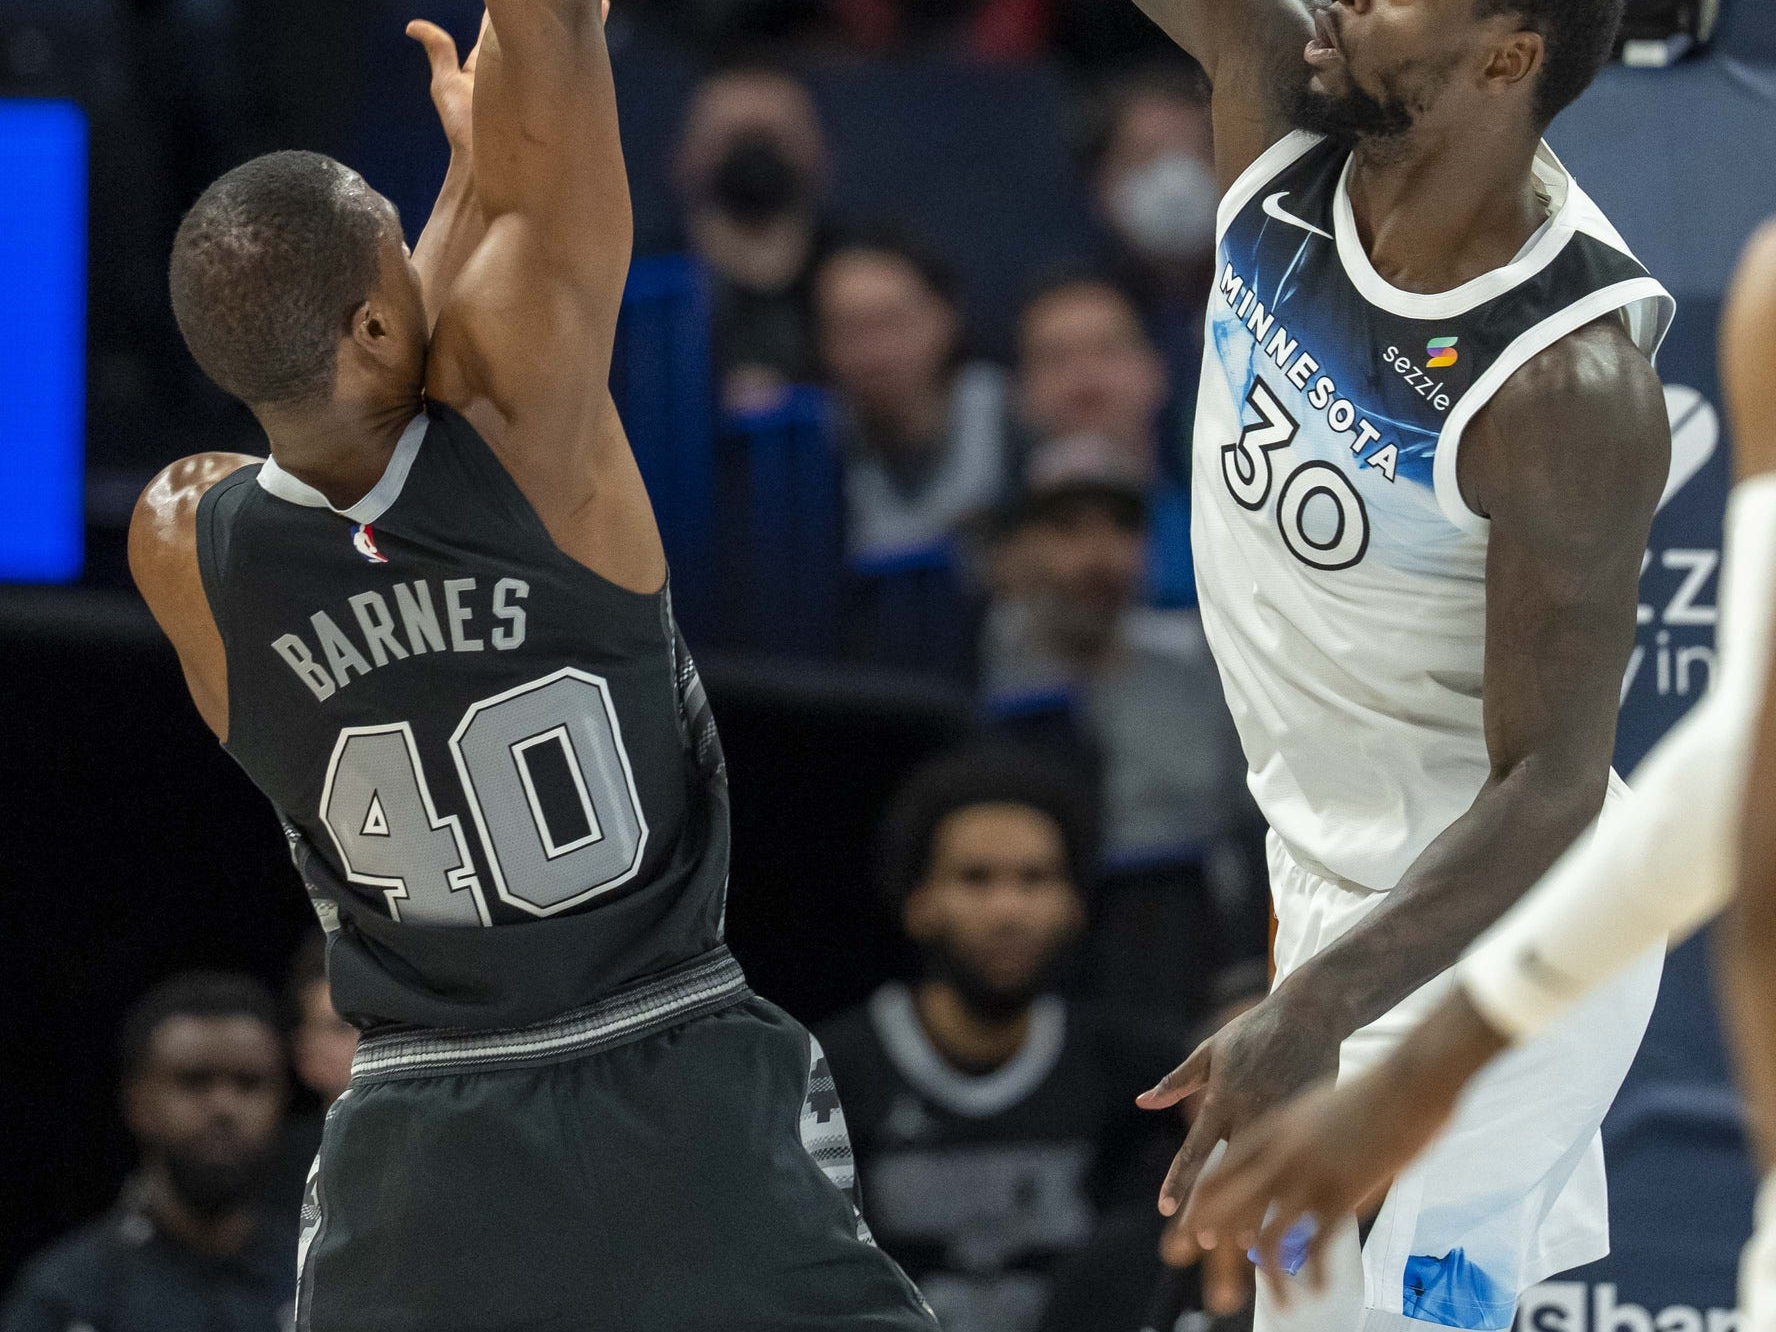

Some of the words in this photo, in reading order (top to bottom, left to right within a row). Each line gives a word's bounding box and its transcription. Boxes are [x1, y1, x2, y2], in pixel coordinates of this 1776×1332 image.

[1219, 262, 1400, 484] MINNESOTA
[1383, 345, 1451, 411] sezzle
[1221, 374, 1370, 571] 30
[271, 577, 530, 703] BARNES
[318, 666, 650, 928] 40
